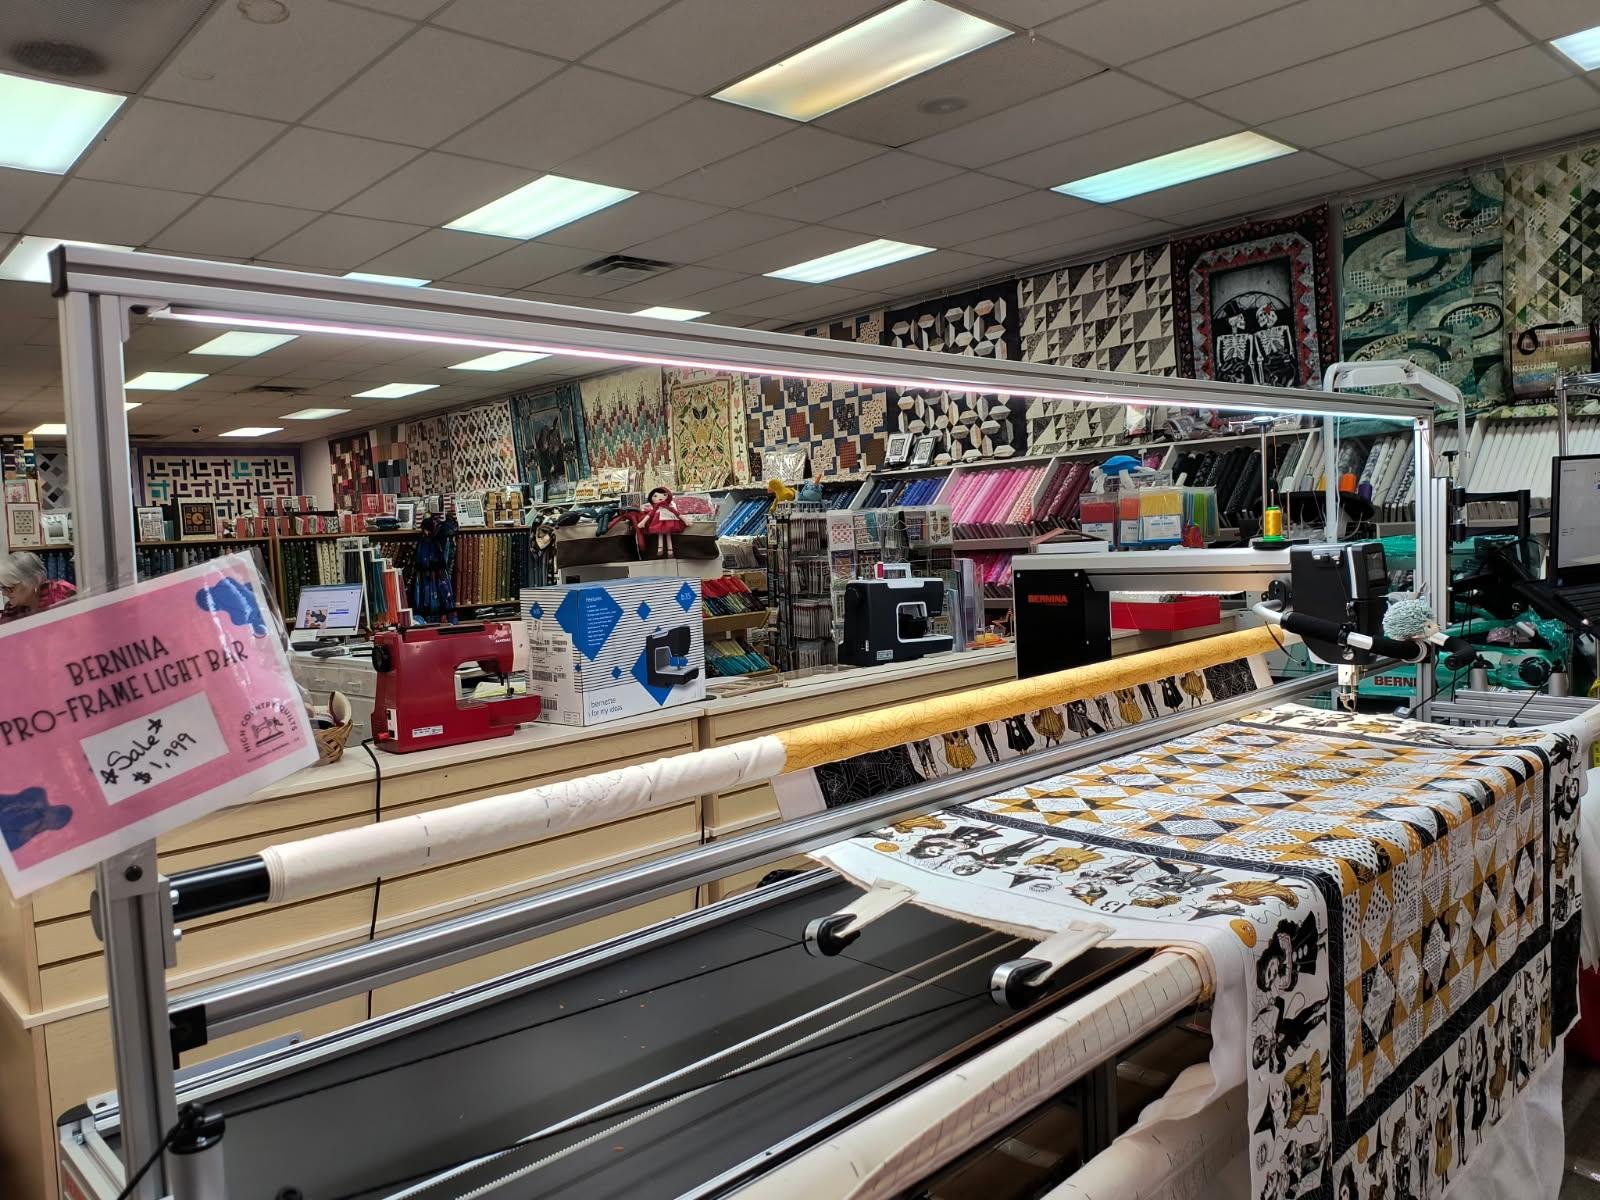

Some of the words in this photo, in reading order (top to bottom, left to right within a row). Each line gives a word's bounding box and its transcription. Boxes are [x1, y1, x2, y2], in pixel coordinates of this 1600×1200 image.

[1027, 594, 1068, 603] BERNINA
[66, 635, 169, 687] BERNINA
[0, 675, 144, 747] PRO-FRAME
[143, 655, 203, 695] LIGHT
[204, 640, 249, 672] BAR
[240, 730, 252, 752] HIGH
[279, 704, 298, 731] QUILTS
